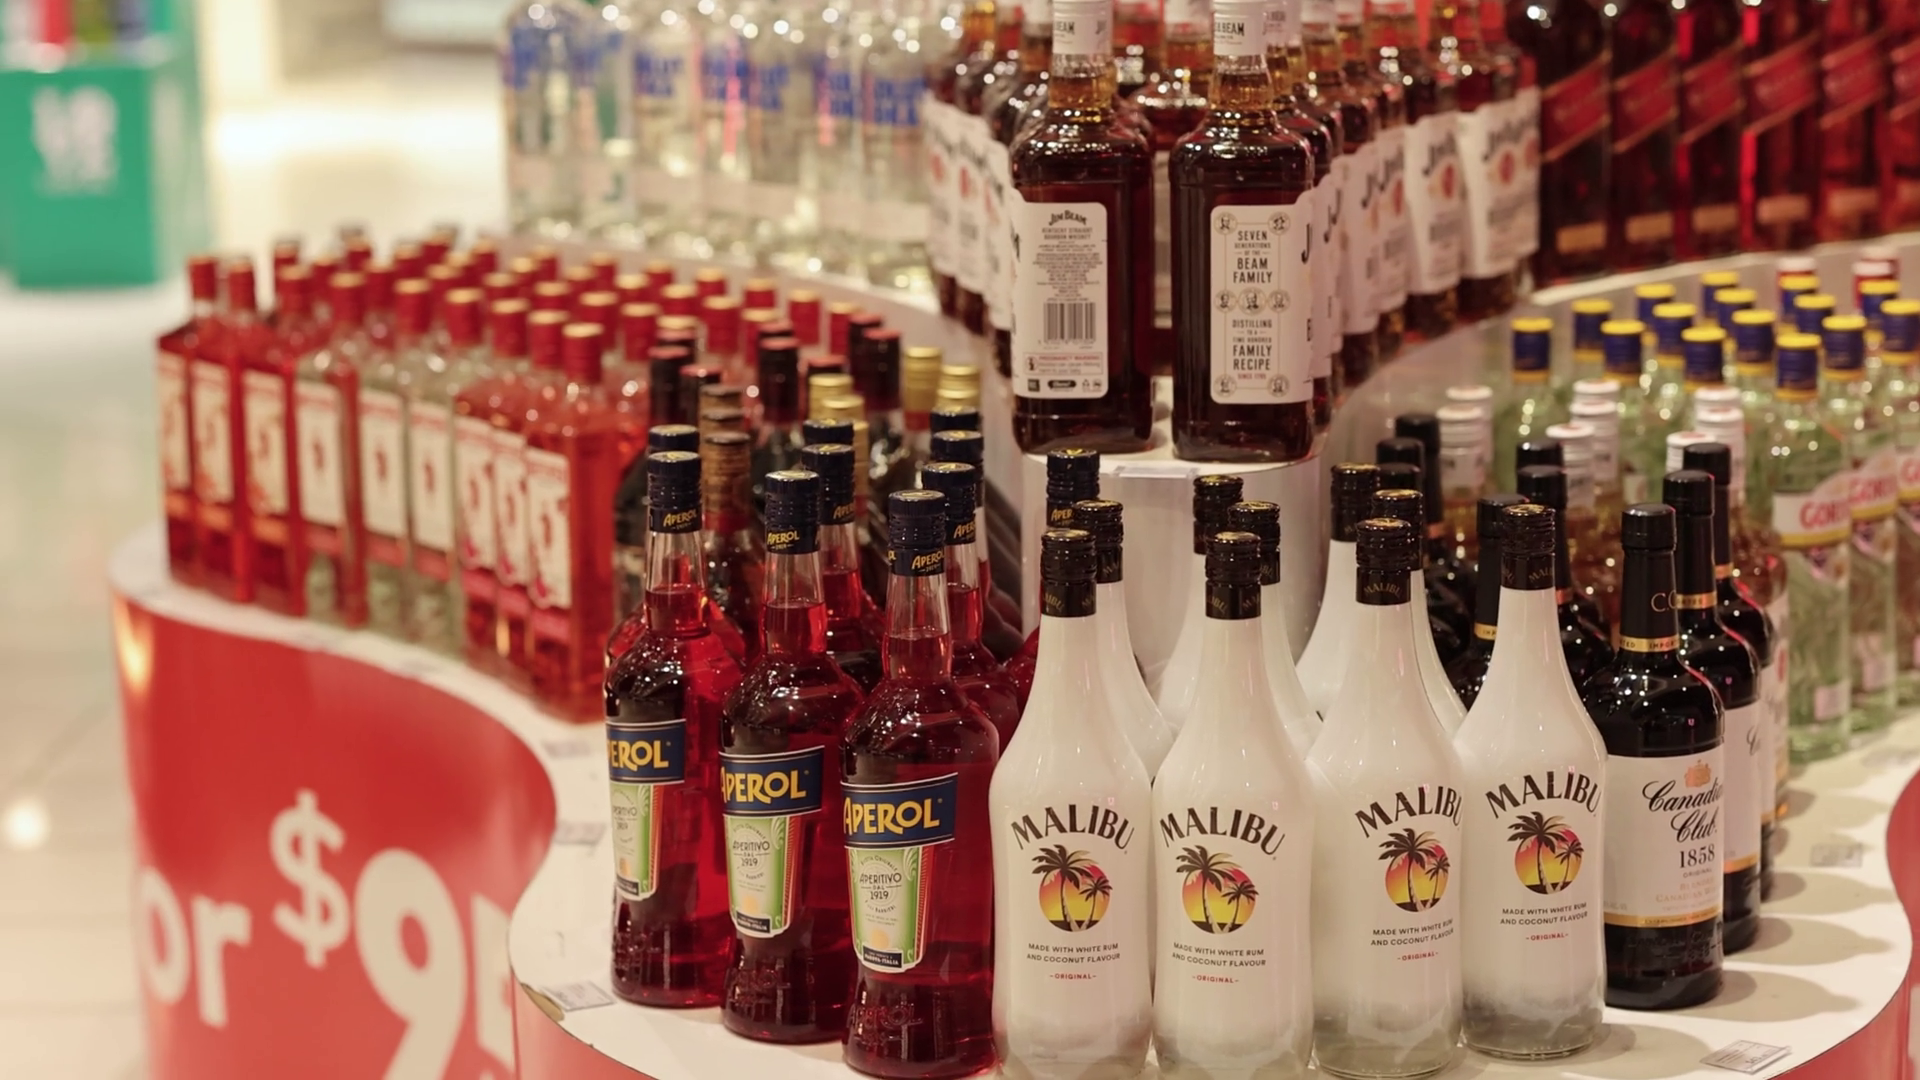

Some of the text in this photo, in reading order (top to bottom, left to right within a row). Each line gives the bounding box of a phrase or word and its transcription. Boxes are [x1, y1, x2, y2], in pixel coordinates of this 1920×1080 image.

[1222, 21, 1245, 36] BEAM
[1049, 209, 1087, 226] JIM BEAM
[1237, 230, 1268, 241] SEVEN
[1237, 257, 1268, 270] BEAM
[1233, 271, 1272, 283] FAMILY
[1232, 319, 1272, 328] DISTILLING
[1233, 345, 1272, 357] FAMILY
[1233, 358, 1270, 371] RECIPE
[663, 508, 697, 528] APEROL
[766, 530, 800, 545] APEROL
[721, 766, 806, 804] APEROL
[1485, 771, 1601, 820] MALIBU
[844, 796, 940, 836] APEROL
[1355, 785, 1462, 839] MALIBU
[1011, 804, 1135, 851] MALIBU
[1159, 806, 1285, 856] MALIBU
[1680, 843, 1716, 869] 1858
[859, 872, 903, 885] APERITIVO
[870, 890, 889, 900] 1919
[1550, 905, 1572, 914] WHITE
[1574, 902, 1587, 910] RUM
[1518, 917, 1558, 925] COCONUT
[1560, 911, 1588, 922] FLAVOUR
[1372, 918, 1454, 936] MADE WITH WHITE RUM
[1390, 936, 1430, 946] COCONUT
[1430, 928, 1454, 940] FLAVOUR
[1028, 943, 1050, 952] MADE
[1103, 943, 1119, 951] RUM
[1174, 942, 1192, 952] MADE
[1194, 946, 1216, 955] WITH
[1218, 949, 1244, 957] WHITE
[1027, 952, 1120, 964] AND COCONUT FLAVOUR
[1172, 952, 1266, 968] AND COCONUT FLAVOUR
